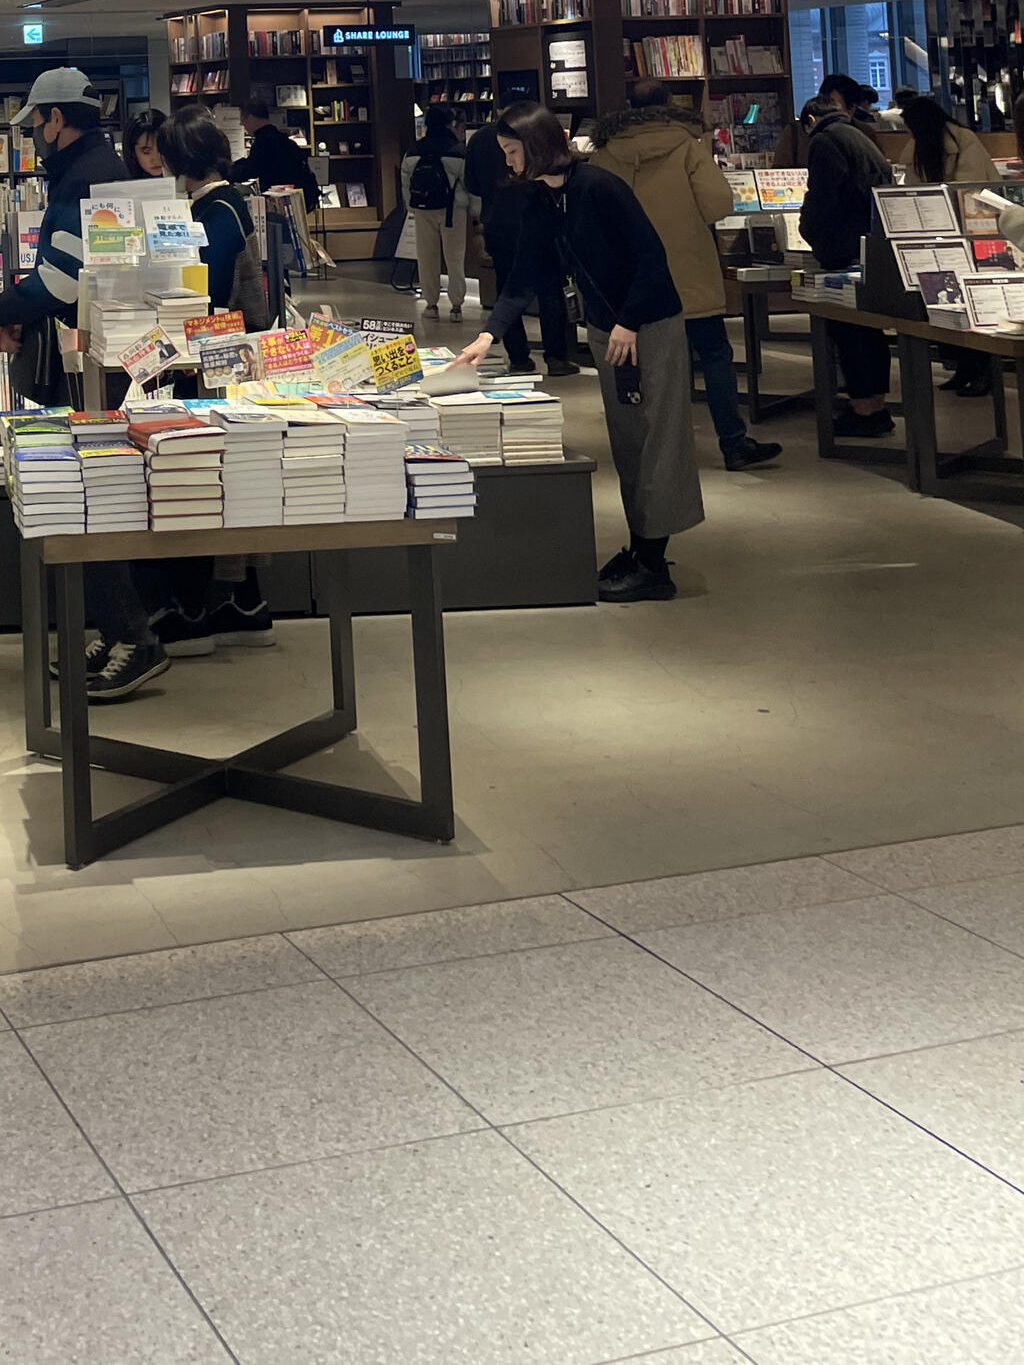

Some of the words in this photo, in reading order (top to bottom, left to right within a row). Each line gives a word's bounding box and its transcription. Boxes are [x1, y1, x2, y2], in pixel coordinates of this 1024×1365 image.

[345, 31, 373, 40] SHARE
[375, 30, 410, 39] LOUNGE
[20, 253, 35, 263] USJ
[372, 346, 406, 367] 思い出を
